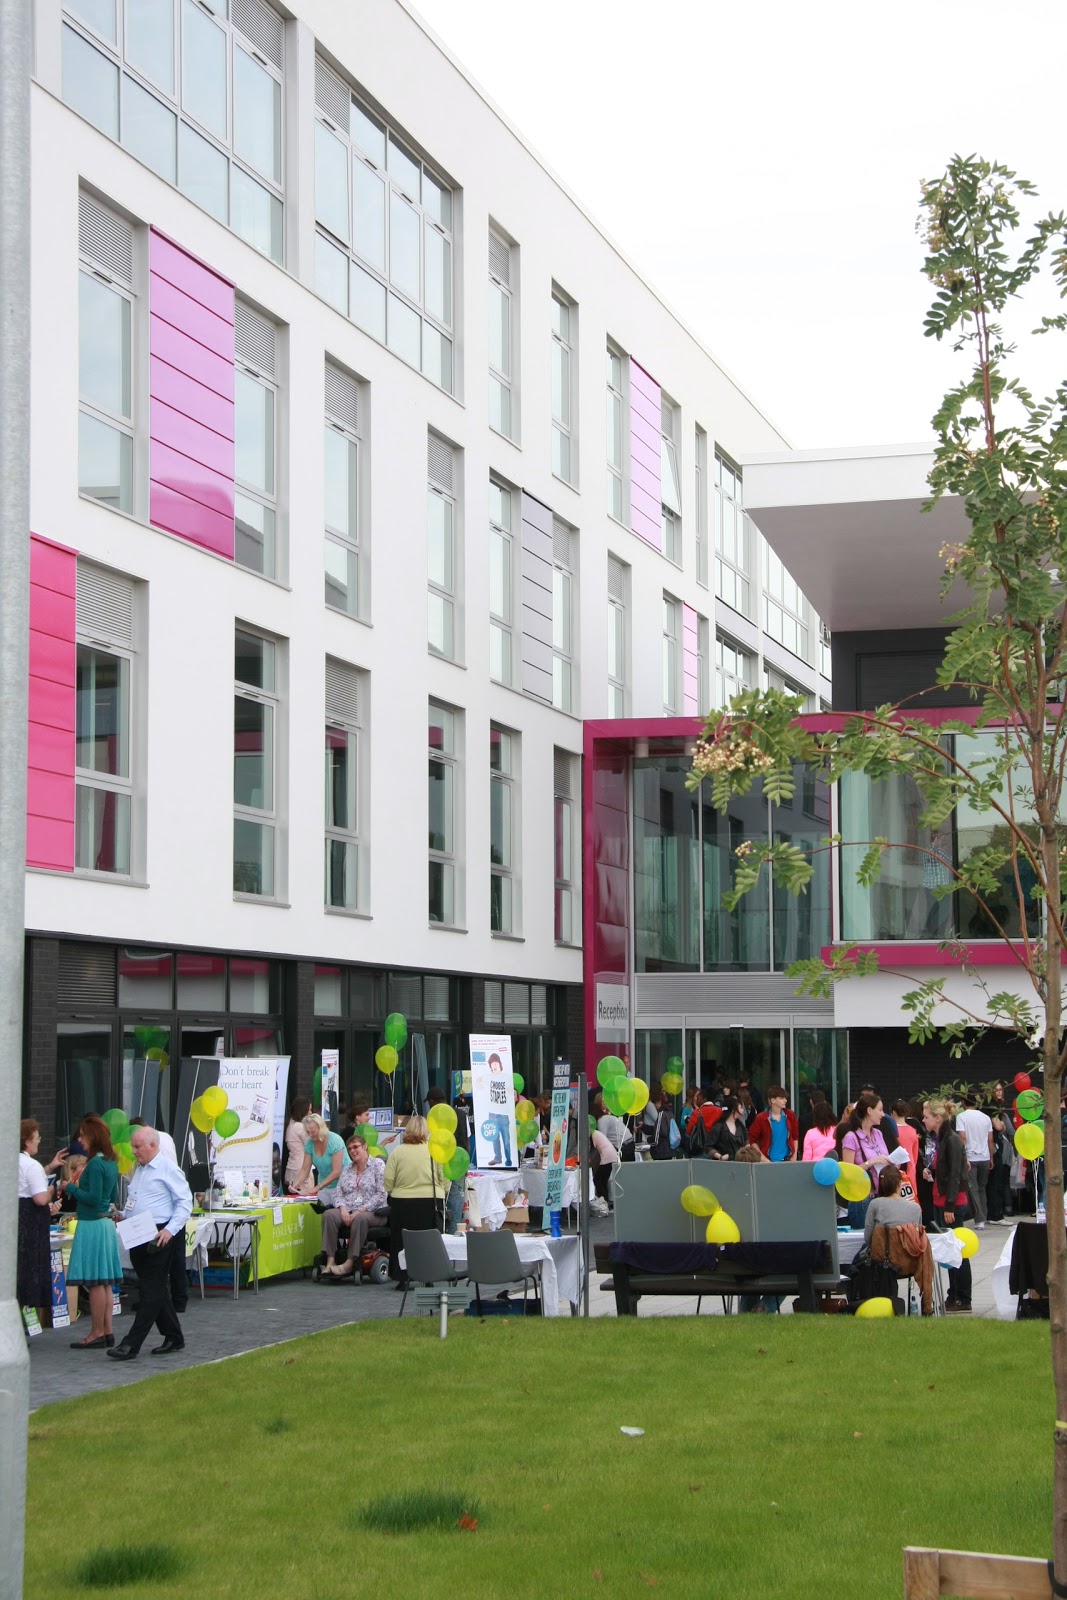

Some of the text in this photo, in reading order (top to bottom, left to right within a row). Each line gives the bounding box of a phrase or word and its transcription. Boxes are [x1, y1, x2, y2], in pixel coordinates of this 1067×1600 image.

[598, 1000, 628, 1026] Reception
[221, 1065, 270, 1076] Don't break
[220, 1079, 262, 1091] your heart
[490, 1080, 506, 1090] CHOOSE
[490, 1090, 507, 1104] STAPLES
[272, 1224, 298, 1238] FOREVER
